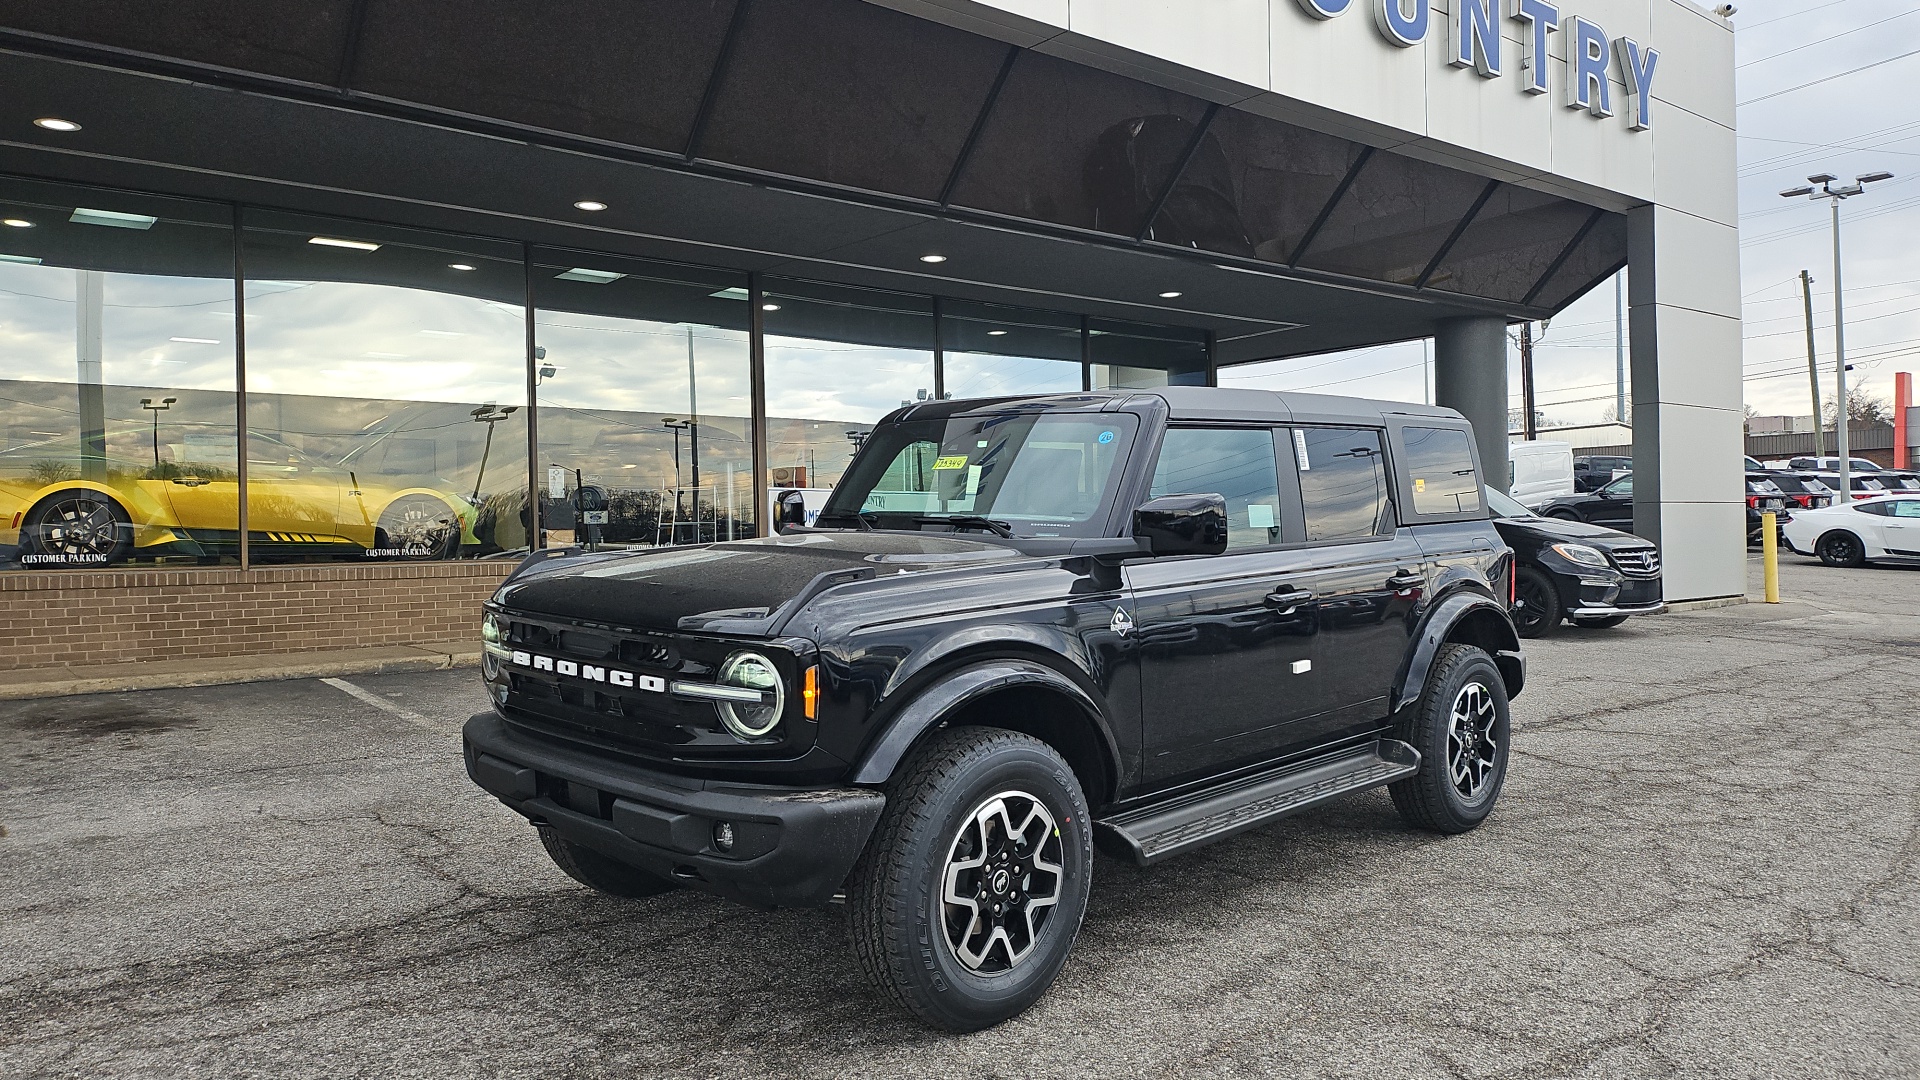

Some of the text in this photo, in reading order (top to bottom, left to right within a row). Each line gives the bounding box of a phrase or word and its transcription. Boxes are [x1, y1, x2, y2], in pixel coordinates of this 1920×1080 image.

[365, 547, 431, 557] CUSTOMER PARKING
[21, 553, 107, 564] CUSTOMER PARKING
[513, 650, 665, 693] BRONCO
